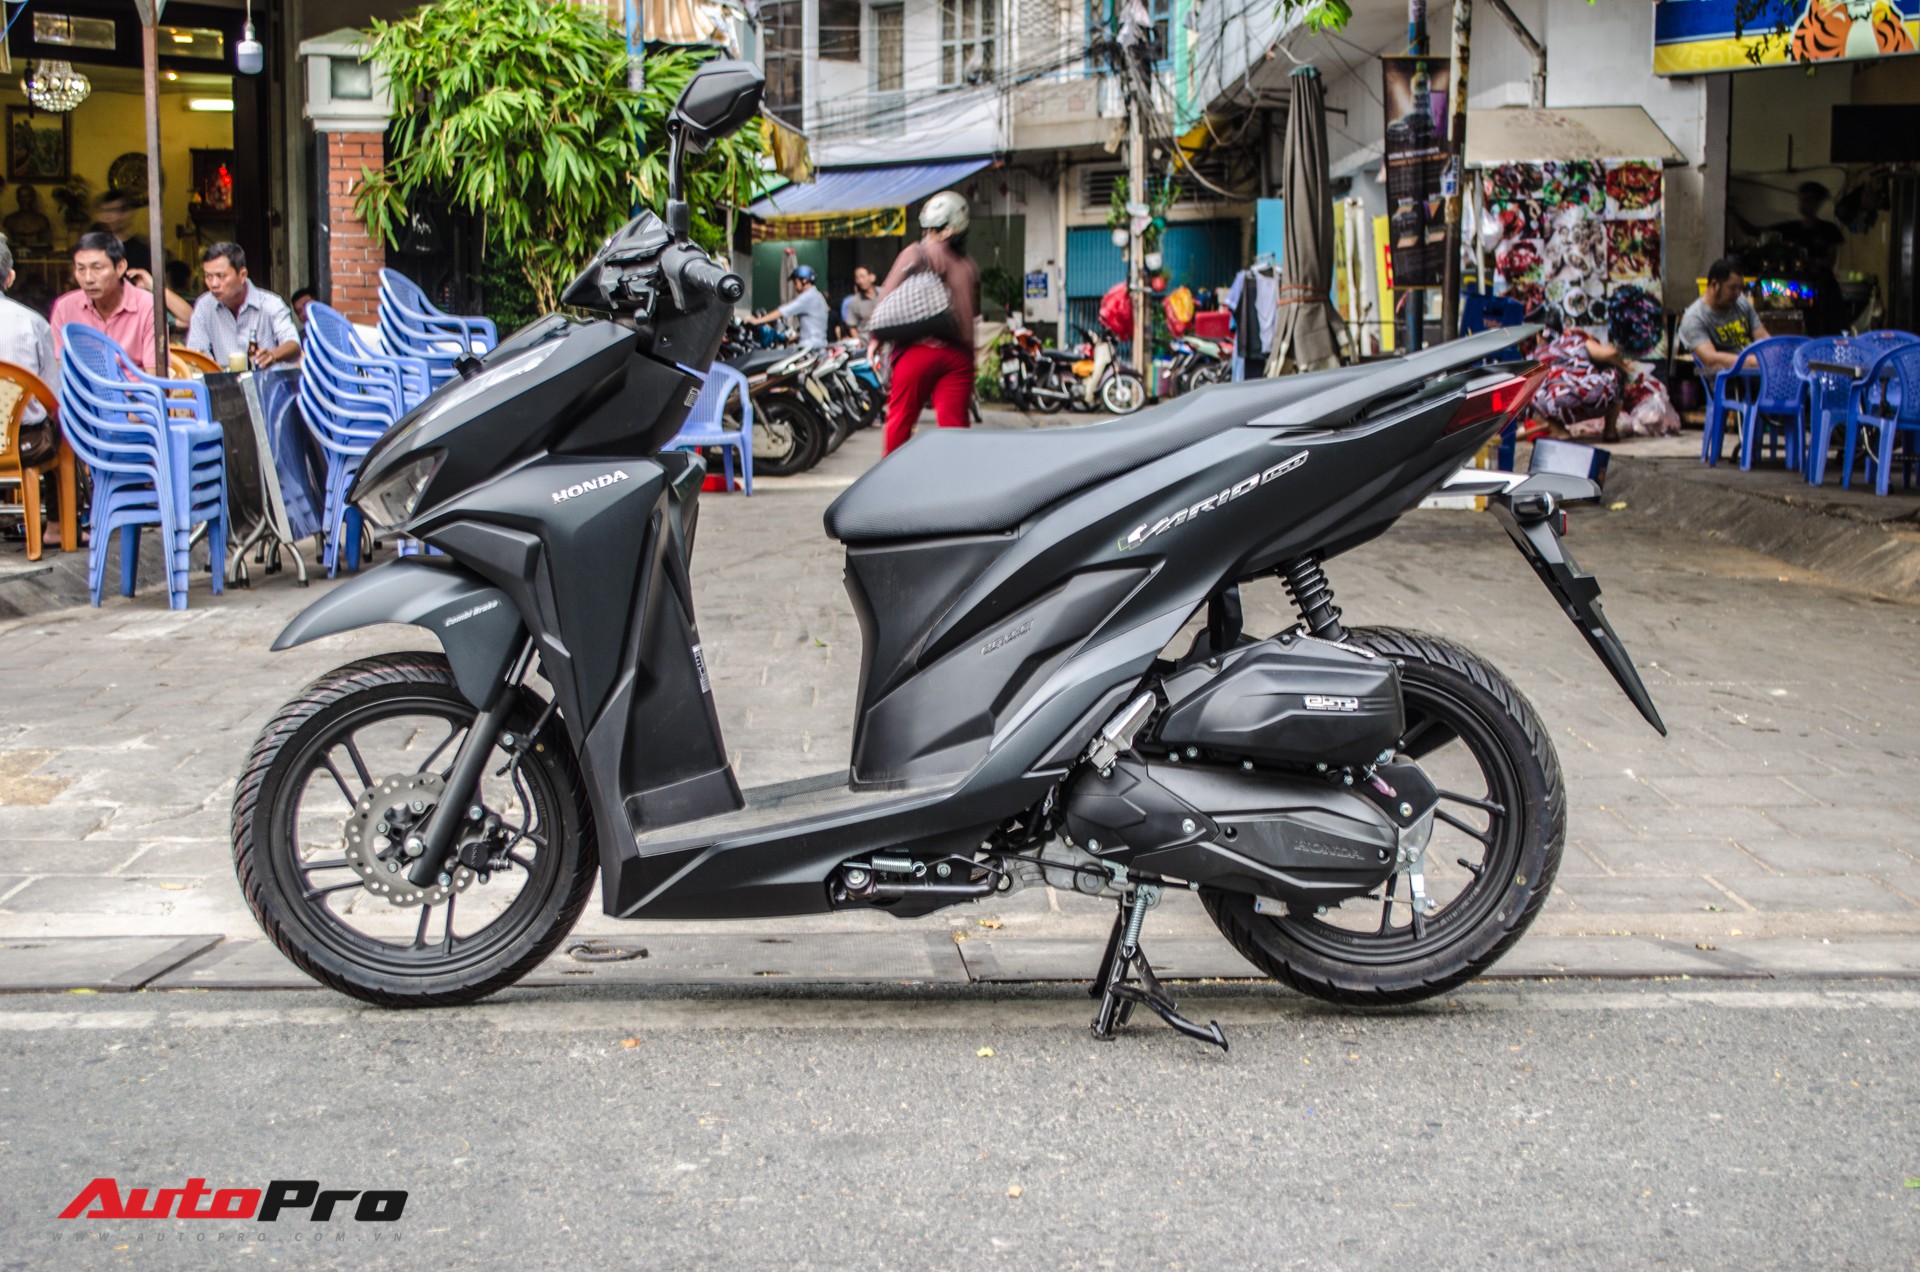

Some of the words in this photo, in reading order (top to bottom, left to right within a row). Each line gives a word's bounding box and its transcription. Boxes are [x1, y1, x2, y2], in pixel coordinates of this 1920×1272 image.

[551, 469, 629, 505] HONDA
[1119, 473, 1260, 550] VARIO
[444, 608, 473, 628] Combi
[472, 599, 499, 617] Brake
[1294, 840, 1366, 861] HONDA
